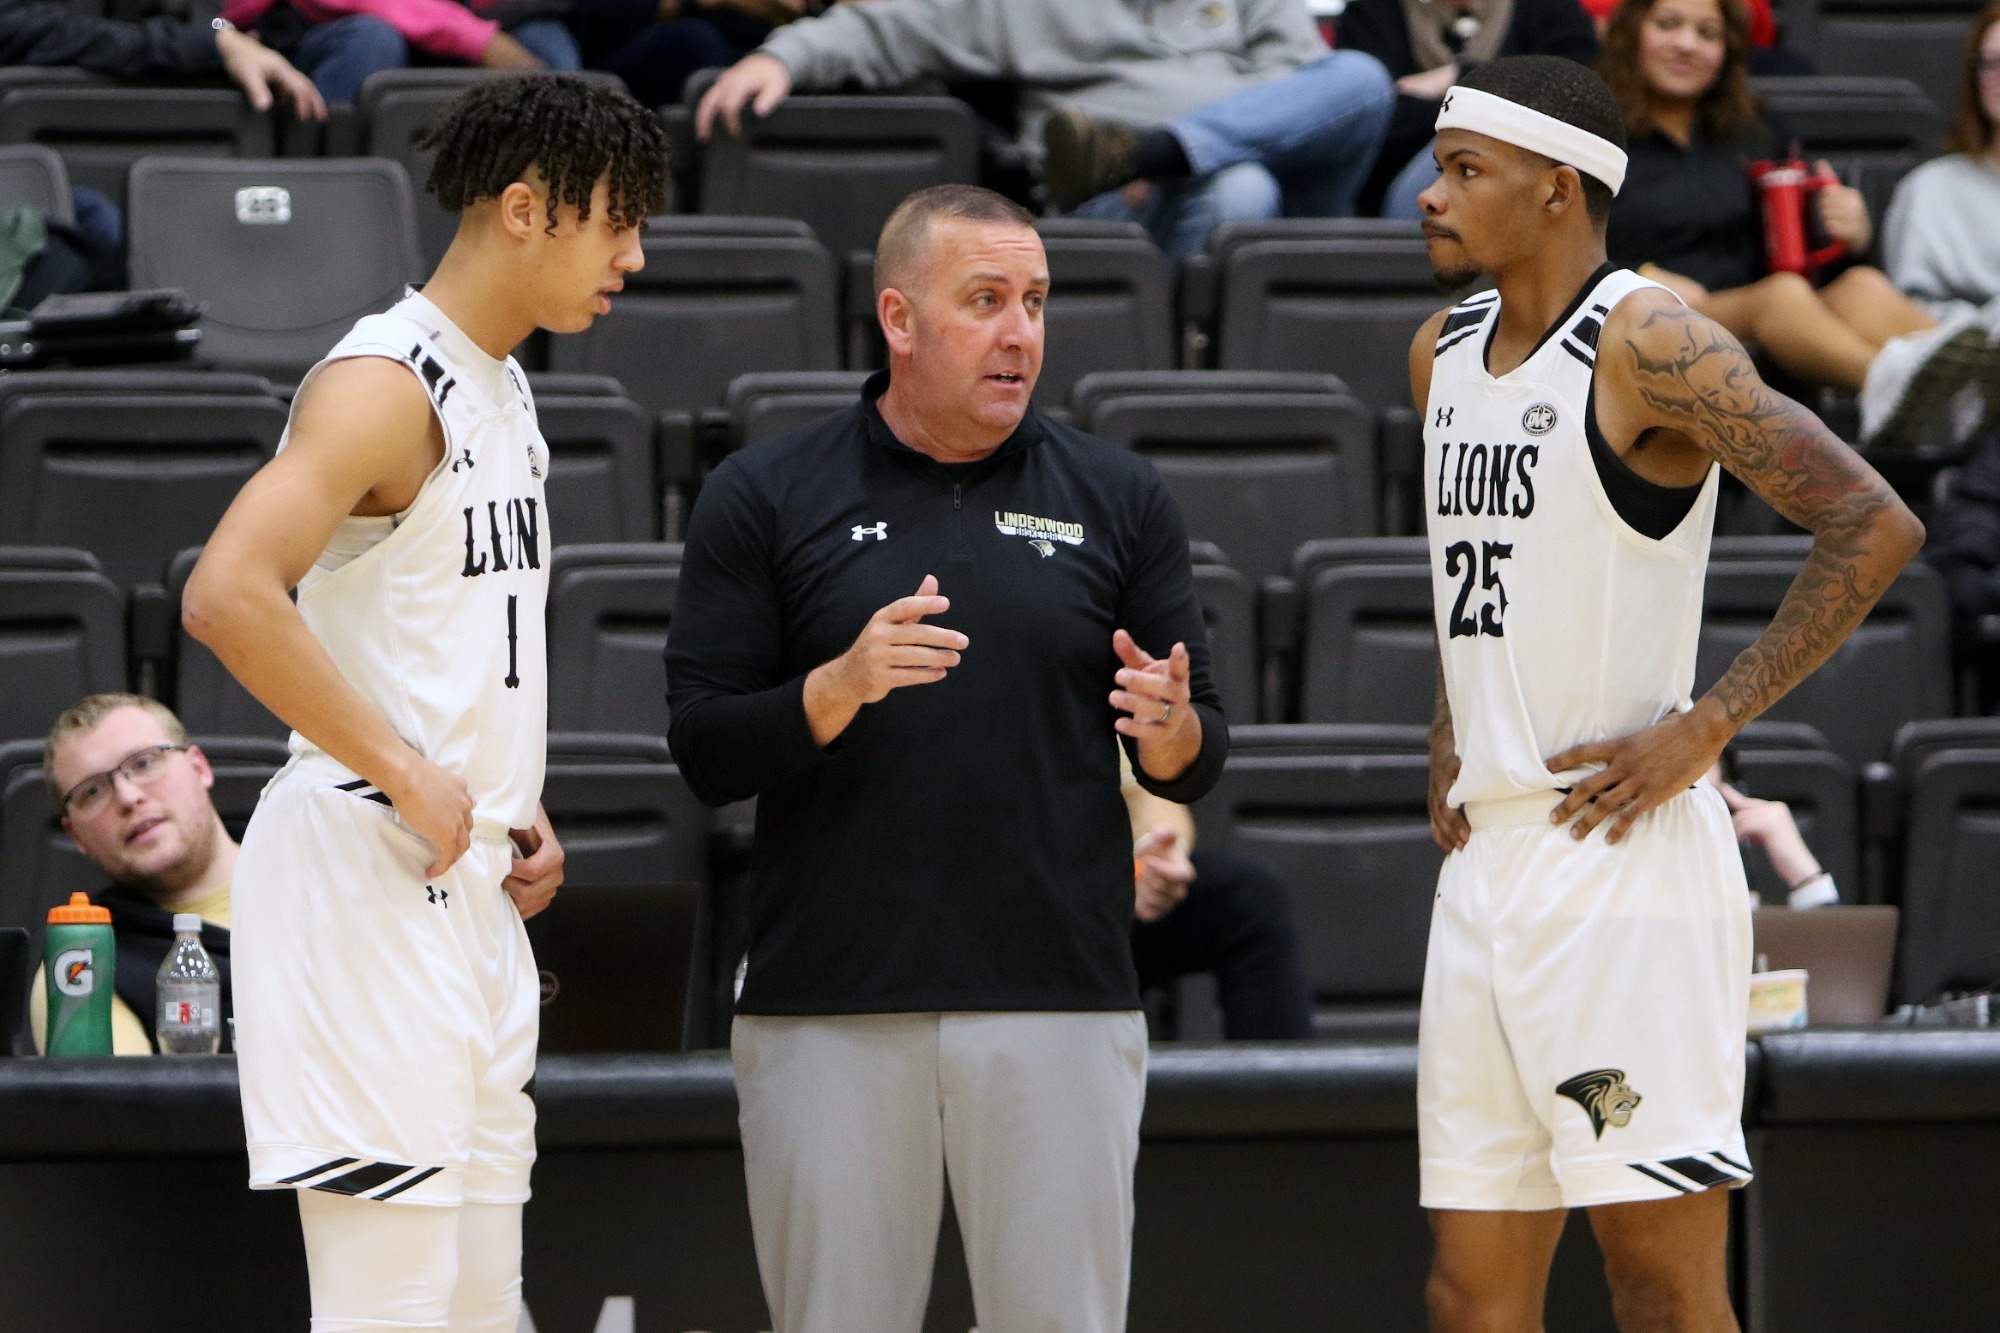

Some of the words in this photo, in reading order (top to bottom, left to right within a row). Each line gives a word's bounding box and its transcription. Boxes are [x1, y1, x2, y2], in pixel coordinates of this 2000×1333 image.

[1438, 442, 1540, 519] LIONS
[994, 511, 1084, 538] LINDENWOOD
[1445, 540, 1513, 639] 25
[504, 594, 520, 689] 1
[54, 949, 93, 996] G
